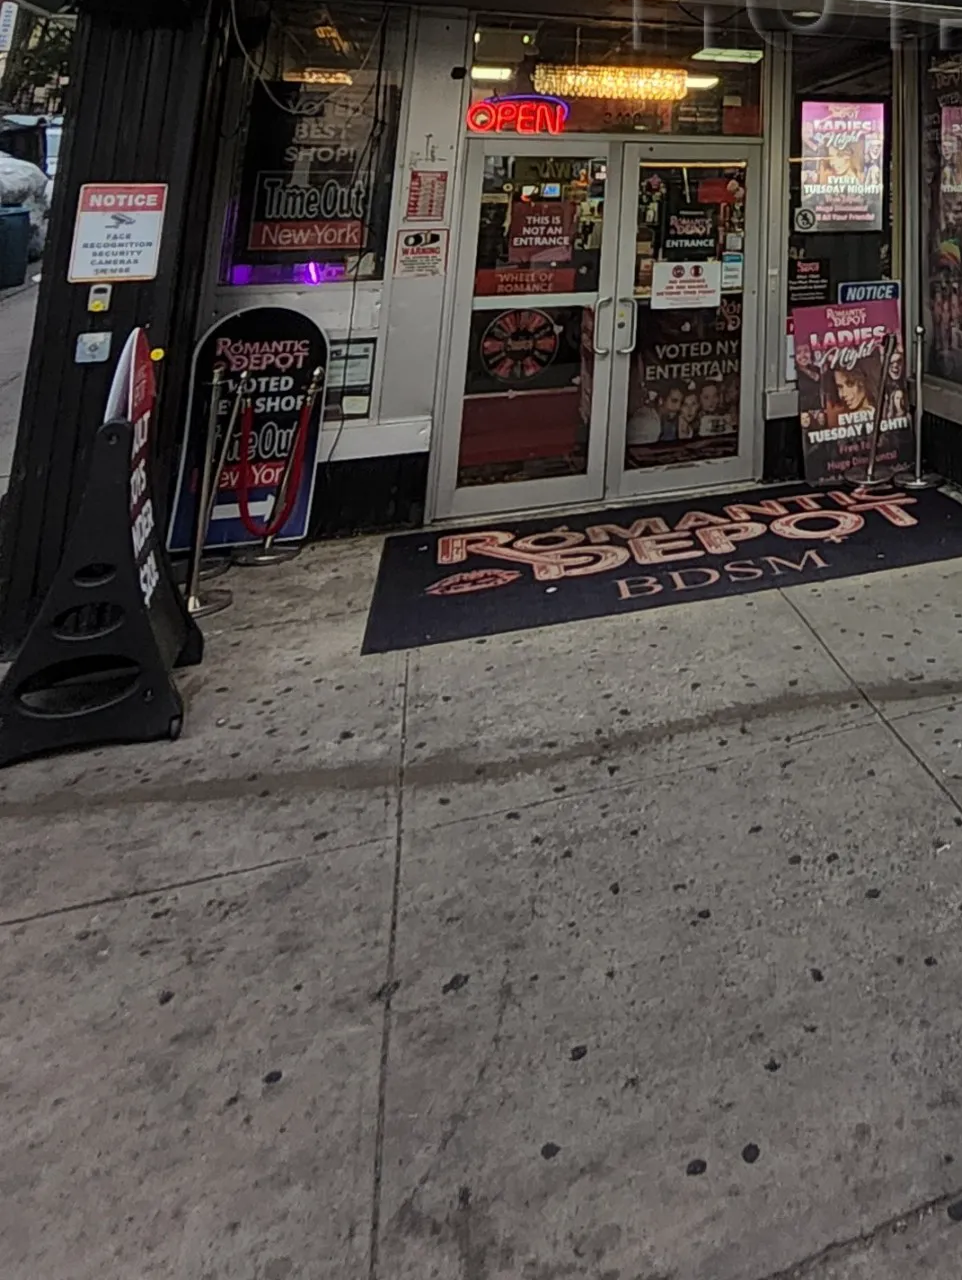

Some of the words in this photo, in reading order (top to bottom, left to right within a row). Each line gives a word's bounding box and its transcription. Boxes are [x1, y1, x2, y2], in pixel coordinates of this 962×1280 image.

[467, 100, 565, 133] OPEN
[284, 146, 355, 162] SHOP!
[89, 194, 158, 207] NOTICE
[264, 177, 320, 220] Time
[321, 178, 365, 219] Out
[526, 216, 550, 225] THIS
[551, 216, 561, 224] IS
[261, 224, 310, 245] New
[312, 224, 359, 244] York
[513, 236, 570, 246] ENTRANCE
[522, 227, 545, 236] NOT
[546, 226, 563, 235] AN
[82, 241, 153, 249] RECOGNITION
[402, 247, 441, 256] WARNING
[665, 239, 715, 248] ENTRANCE
[90, 258, 139, 266] CAMERAS
[846, 285, 894, 301] NOTICE
[216, 337, 310, 357] ROMANTIC
[810, 325, 886, 350] LADIES
[655, 341, 712, 359] VOTED
[716, 340, 739, 356] NY
[820, 339, 875, 371] Night
[230, 352, 310, 372] DEPOT
[645, 359, 739, 380] ENTERTAIN
[838, 409, 875, 426] EVERY
[808, 424, 863, 443] TUESDAY
[865, 417, 909, 435] NGHT!
[251, 465, 285, 485] Yor
[437, 483, 909, 565] ROMANTIC
[530, 496, 919, 581] DEPOT
[613, 548, 831, 601] BDSM
